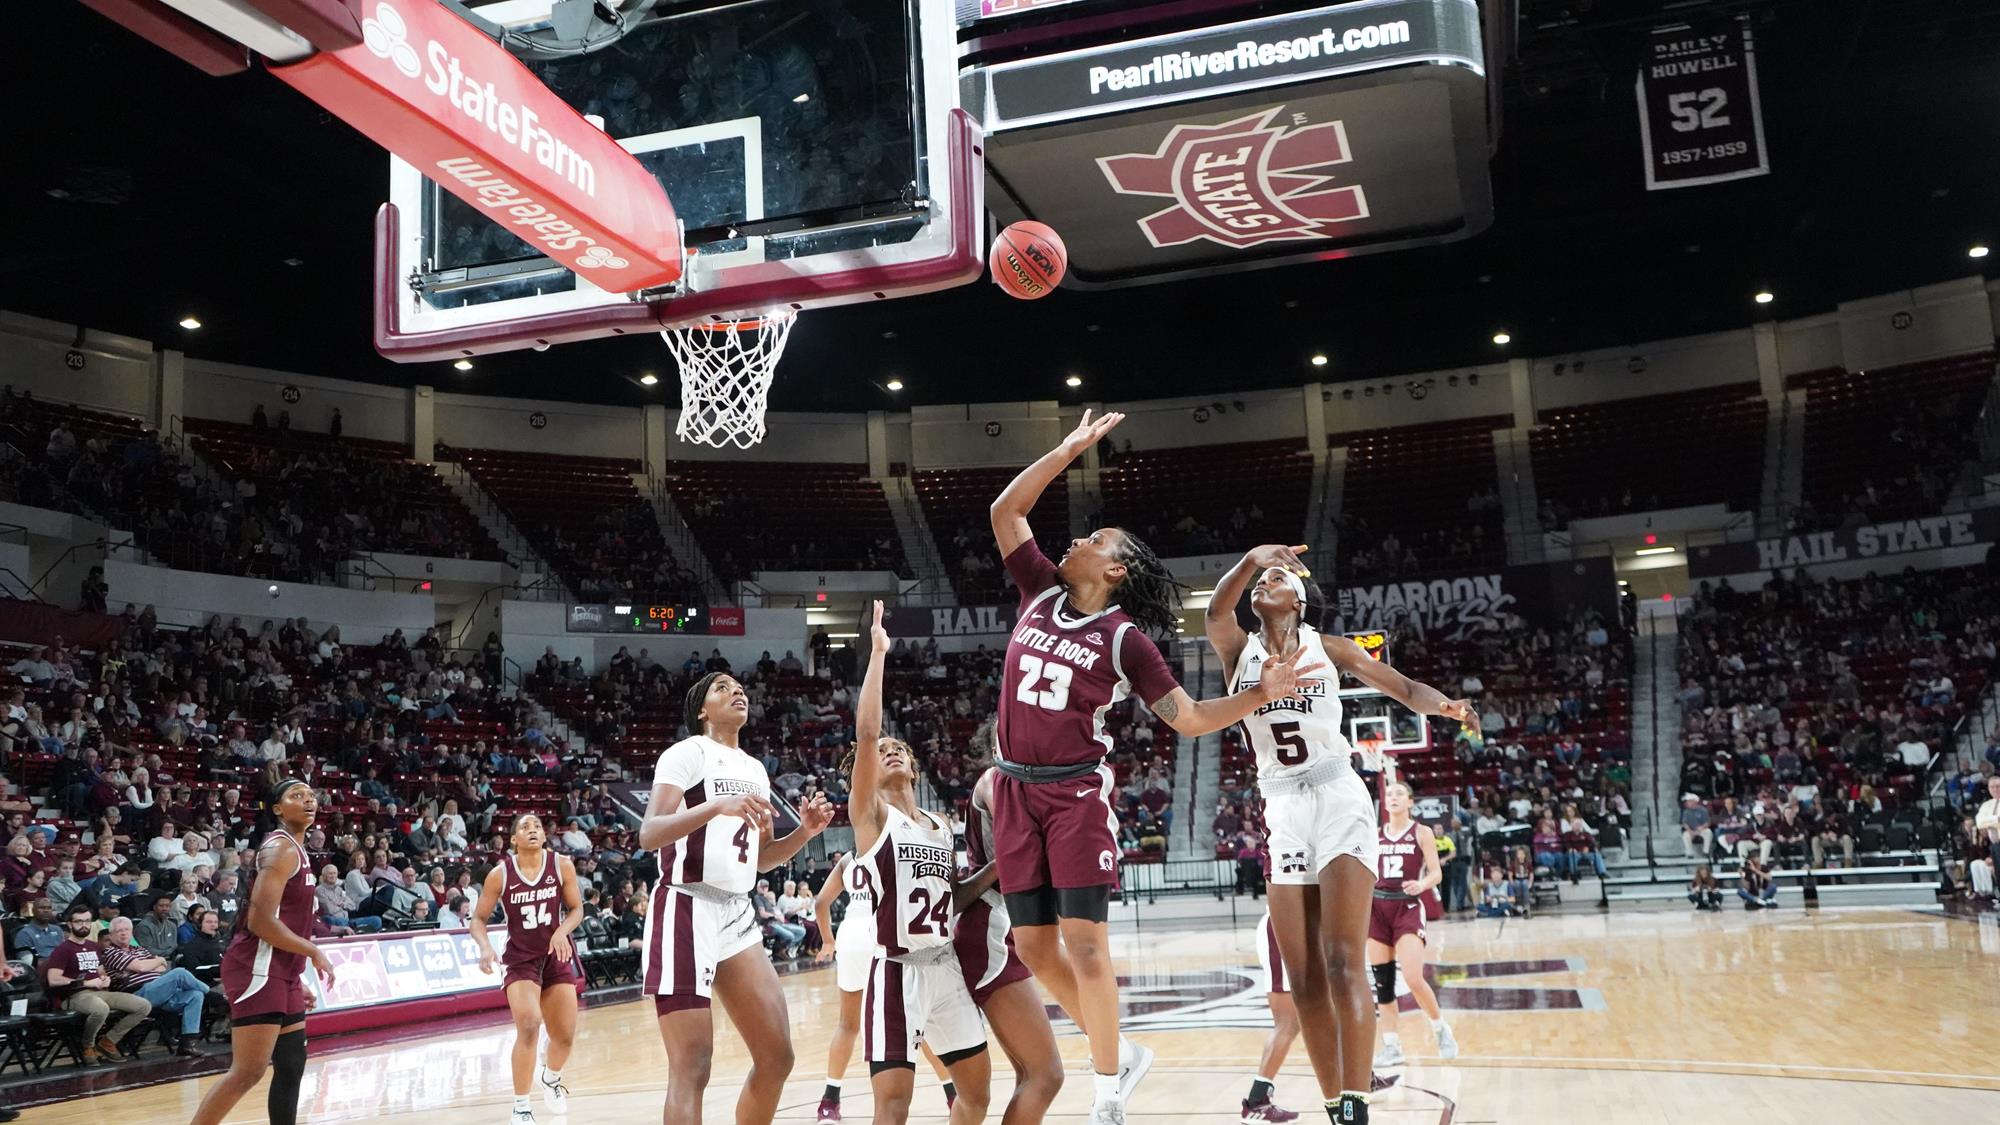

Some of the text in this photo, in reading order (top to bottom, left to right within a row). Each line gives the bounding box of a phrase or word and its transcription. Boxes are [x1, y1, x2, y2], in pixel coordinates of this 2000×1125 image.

[1089, 19, 1410, 95] PearlRiverResort.com
[1651, 54, 1738, 79] HOWELL
[1668, 87, 1731, 132] 52
[1661, 140, 1748, 165] 1957-1959
[1193, 146, 1282, 228] STATE
[1006, 252, 1044, 295] Wilson
[67, 353, 84, 368] 213
[531, 415, 545, 426] 215
[1756, 512, 1977, 570] HAIL STATE
[817, 576, 827, 587] H
[1338, 573, 1503, 616] THE MAROON
[634, 617, 640, 626] 3
[677, 618, 684, 627] 2
[649, 607, 674, 619] 6:20
[931, 605, 1008, 635] HAIL
[662, 621, 668, 631] 3
[1015, 625, 1101, 671] LITTLE ROCK
[1016, 653, 1074, 712] 23
[1261, 698, 1303, 713] STATE
[1270, 721, 1309, 767] 5
[732, 821, 750, 865] 4
[898, 845, 953, 866] MISSISSI
[919, 864, 951, 881] STATE
[1383, 855, 1404, 879] 12
[510, 885, 558, 904] LITTLE ROCK
[520, 902, 552, 930] 34
[907, 887, 952, 938] 24
[386, 944, 411, 968] 43
